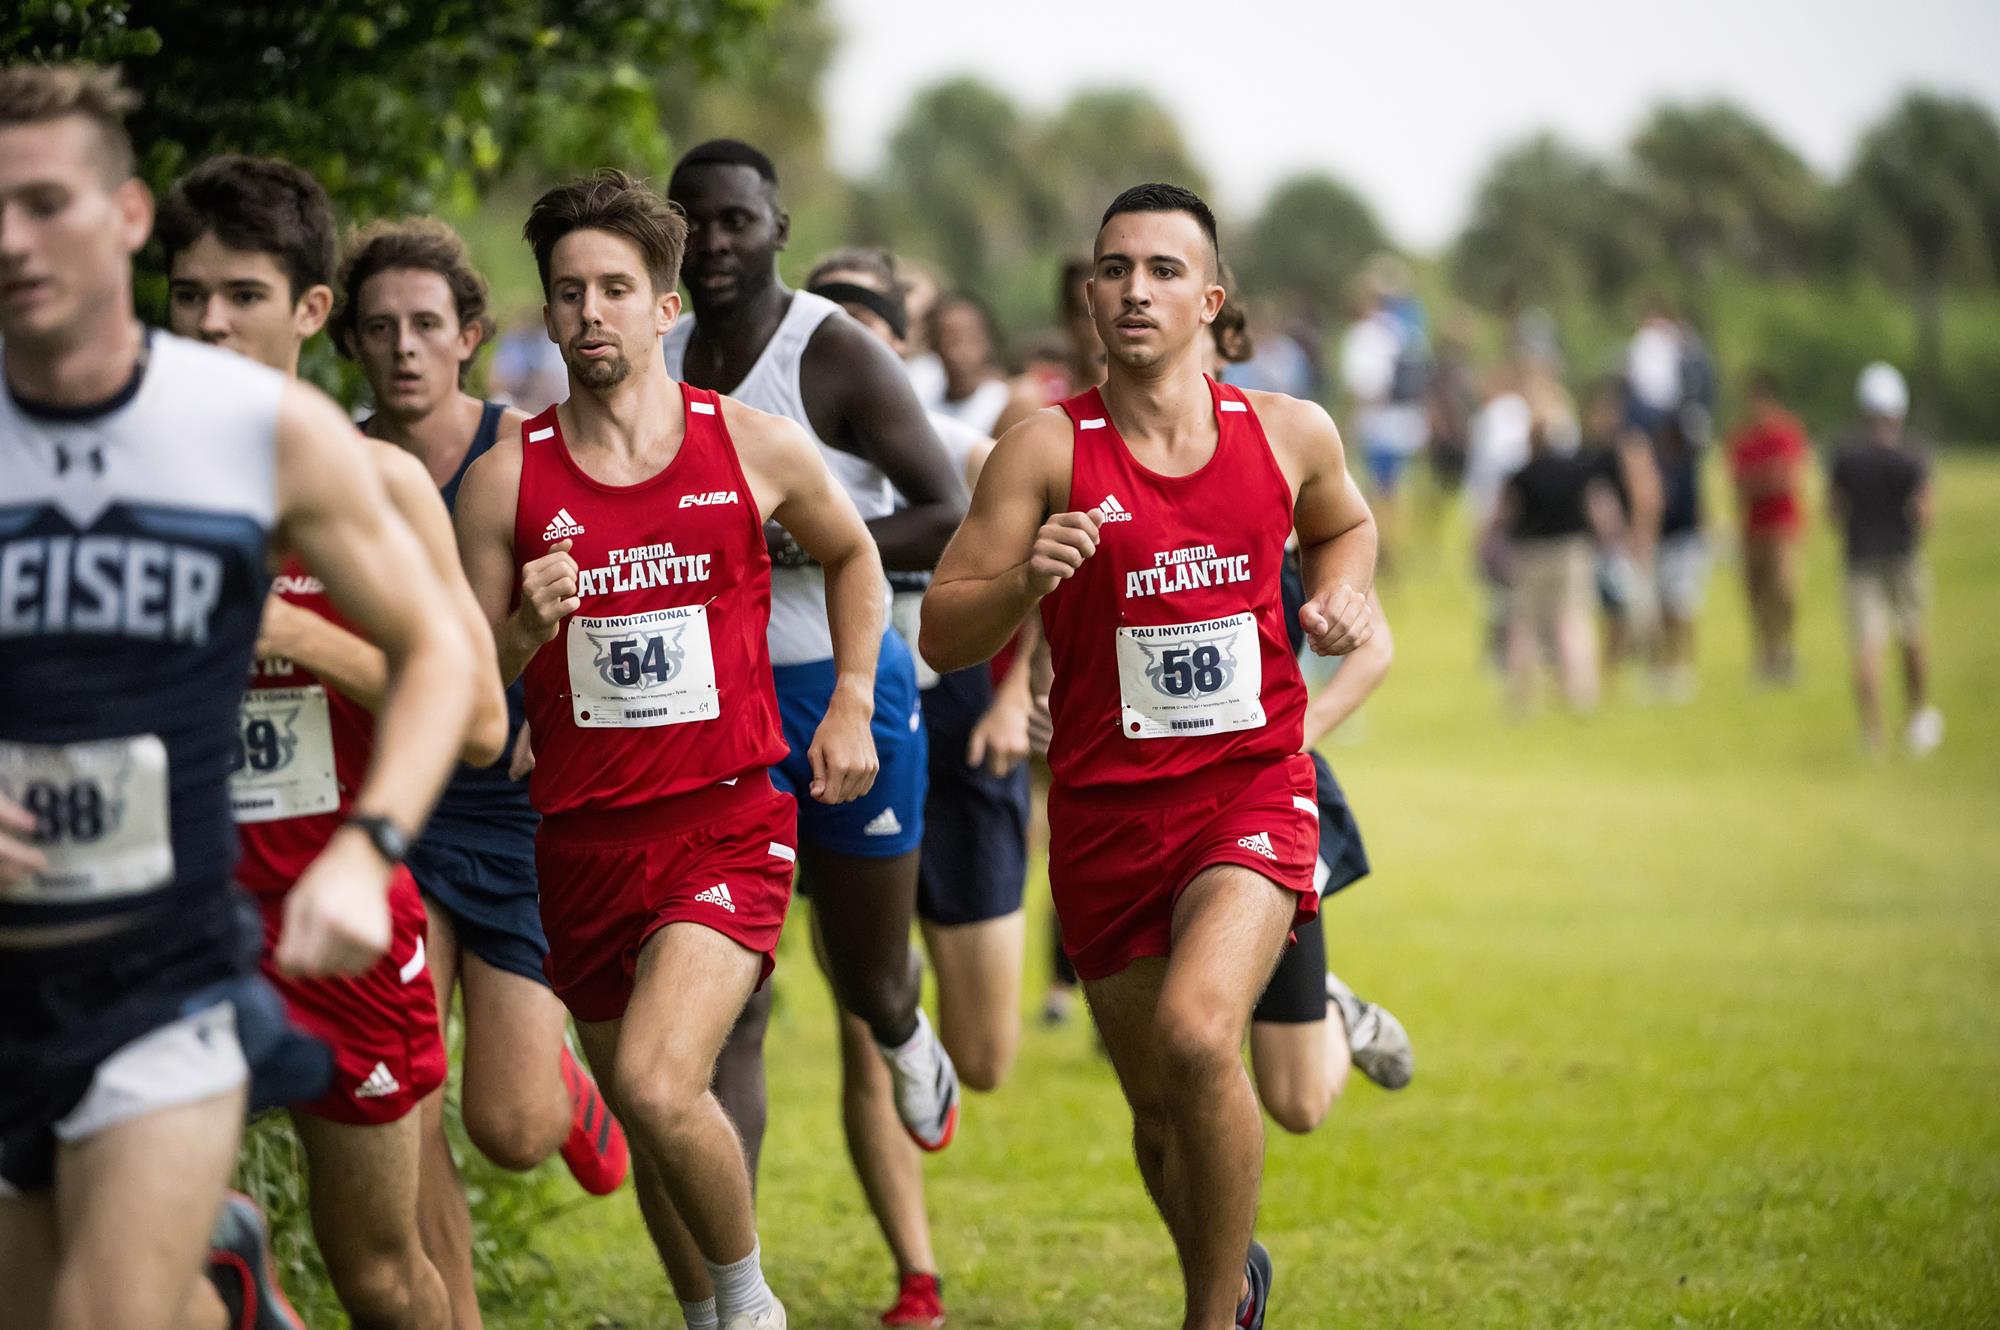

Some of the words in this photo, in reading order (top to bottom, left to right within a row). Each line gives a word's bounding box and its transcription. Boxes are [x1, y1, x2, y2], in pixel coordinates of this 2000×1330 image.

[1101, 511, 1132, 523] idas
[542, 525, 585, 541] adidas
[608, 542, 676, 565] FLORIDA
[1154, 544, 1217, 567] FLORIDA
[577, 554, 712, 598] ATLANTIC
[1125, 554, 1251, 599] ATLANTIC
[0, 535, 223, 647] EISER
[581, 619, 602, 628] FAU
[606, 608, 691, 628] INVITATIONAL
[1131, 627, 1155, 638] FAU
[1158, 616, 1243, 637] INVITATIONAL
[609, 636, 670, 685] 54
[1163, 645, 1222, 694] 58
[699, 701, 709, 713] 54
[694, 893, 736, 913] adidas
